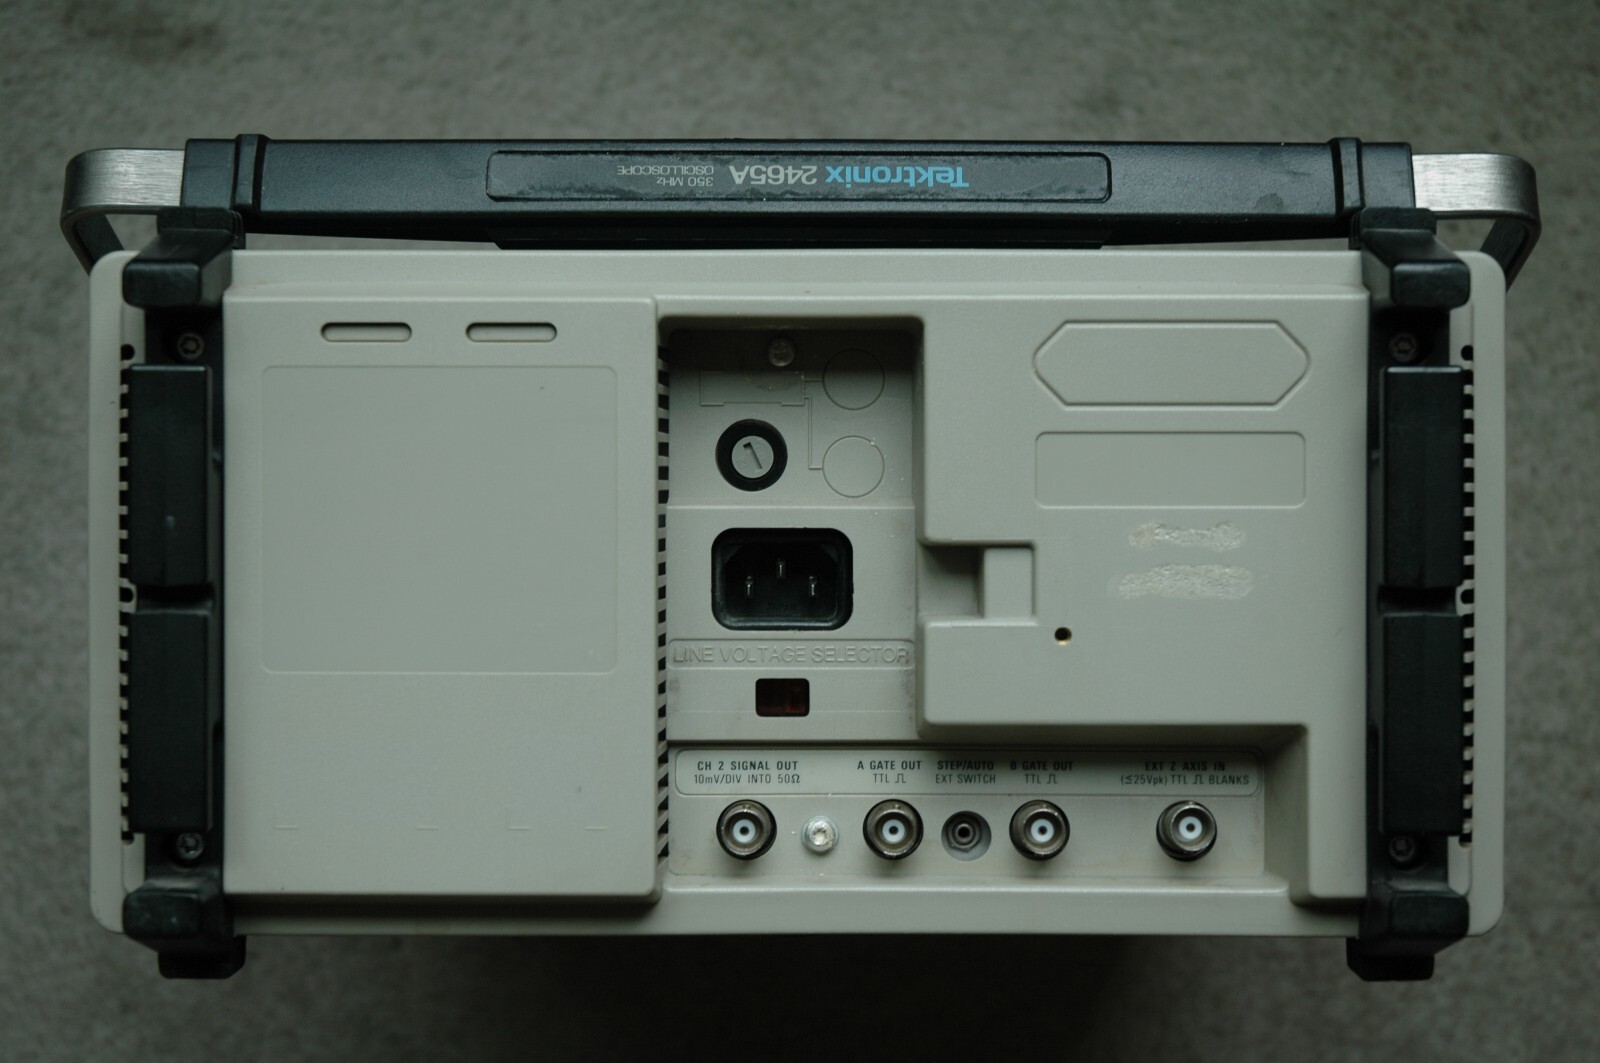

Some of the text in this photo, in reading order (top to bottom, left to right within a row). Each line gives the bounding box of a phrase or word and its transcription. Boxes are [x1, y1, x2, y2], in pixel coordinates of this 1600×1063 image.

[617, 165, 714, 175] OSCILLOSCOPE
[656, 176, 714, 187] 350 MHz
[729, 165, 970, 188] Tektronix 2465A
[672, 646, 910, 664] LINE VOLTAGE SELECTOR
[697, 760, 798, 771] CH 2 SIGNAL OUT
[857, 760, 922, 770] A GATE OUT
[937, 760, 994, 771] STEP/AUTO
[1010, 760, 1074, 771] B GATE OUT
[1144, 760, 1225, 771] EXT Z AXIS IN
[694, 773, 800, 784] 10mV/DIV INTO 50Ω
[873, 773, 890, 783] TTL
[935, 773, 996, 784] EXT SWITCH
[1024, 773, 1041, 784] TTL
[1171, 774, 1188, 785] TTL
[1208, 774, 1250, 785] BLANKS
